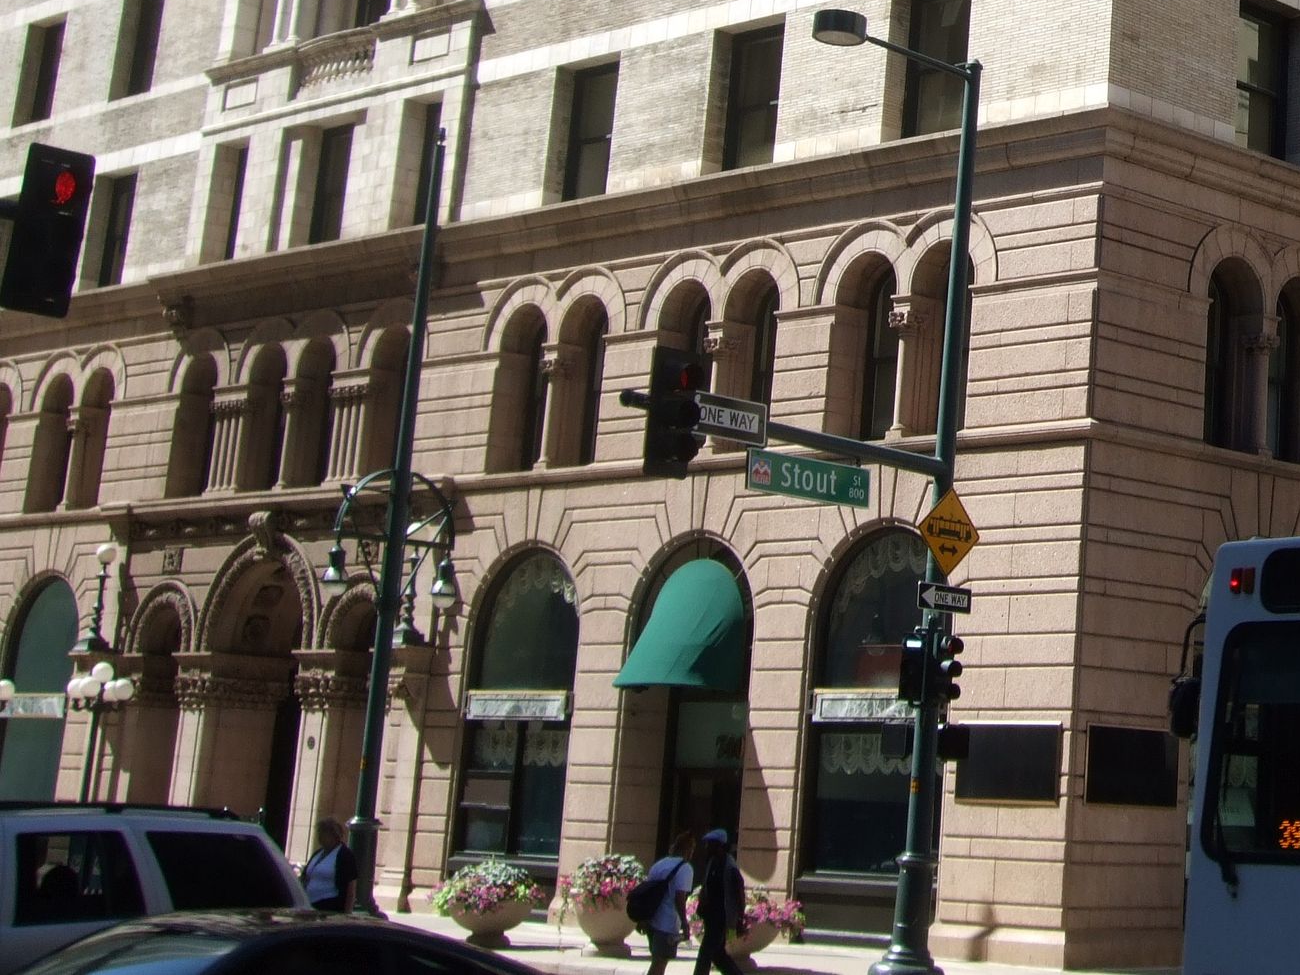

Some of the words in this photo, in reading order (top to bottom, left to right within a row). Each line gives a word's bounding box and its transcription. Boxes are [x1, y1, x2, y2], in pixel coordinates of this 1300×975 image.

[700, 405, 725, 425] ONE
[729, 411, 755, 431] WAY
[781, 463, 837, 495] Stout
[852, 475, 861, 486] St
[848, 487, 864, 500] 800
[934, 592, 948, 604] ONE
[951, 594, 966, 606] WAY
